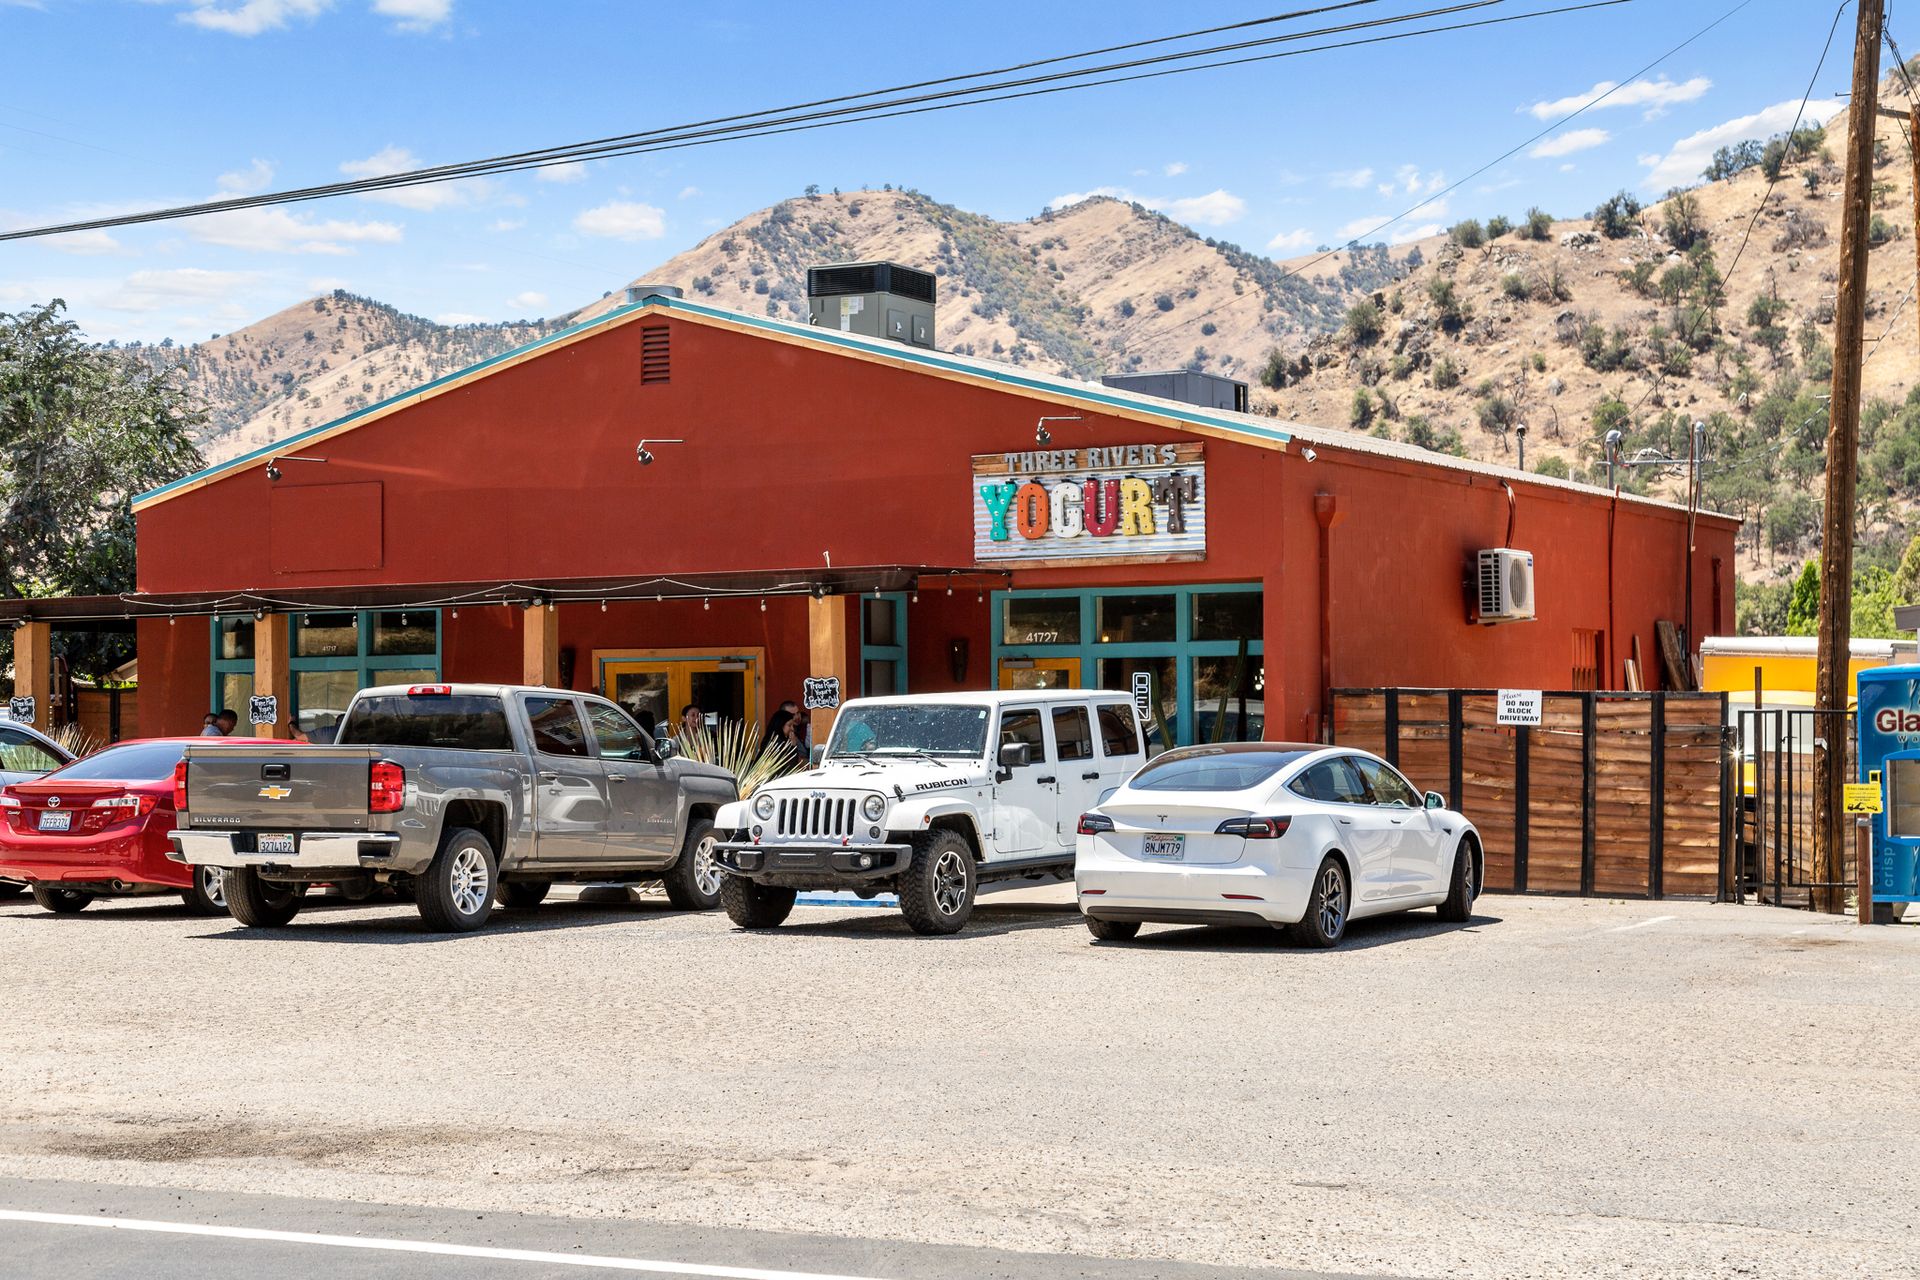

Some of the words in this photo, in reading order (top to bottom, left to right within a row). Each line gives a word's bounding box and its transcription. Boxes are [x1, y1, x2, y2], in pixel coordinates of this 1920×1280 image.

[1004, 449, 1078, 473] THREE
[1087, 444, 1177, 468] RIVERS
[980, 475, 1197, 542] YOGURT
[1025, 632, 1059, 643] 41727
[1134, 673, 1149, 720] OPEN
[1507, 707, 1532, 715] BLOCK
[1499, 714, 1540, 722] DRIVEWAY
[915, 778, 968, 791] RUBICON
[810, 790, 827, 799] Jeep
[42, 817, 69, 828] 7FFR374
[261, 841, 292, 852] 32741P2
[1144, 842, 1181, 854] 8NJM779
[1882, 847, 1896, 888] crisp
